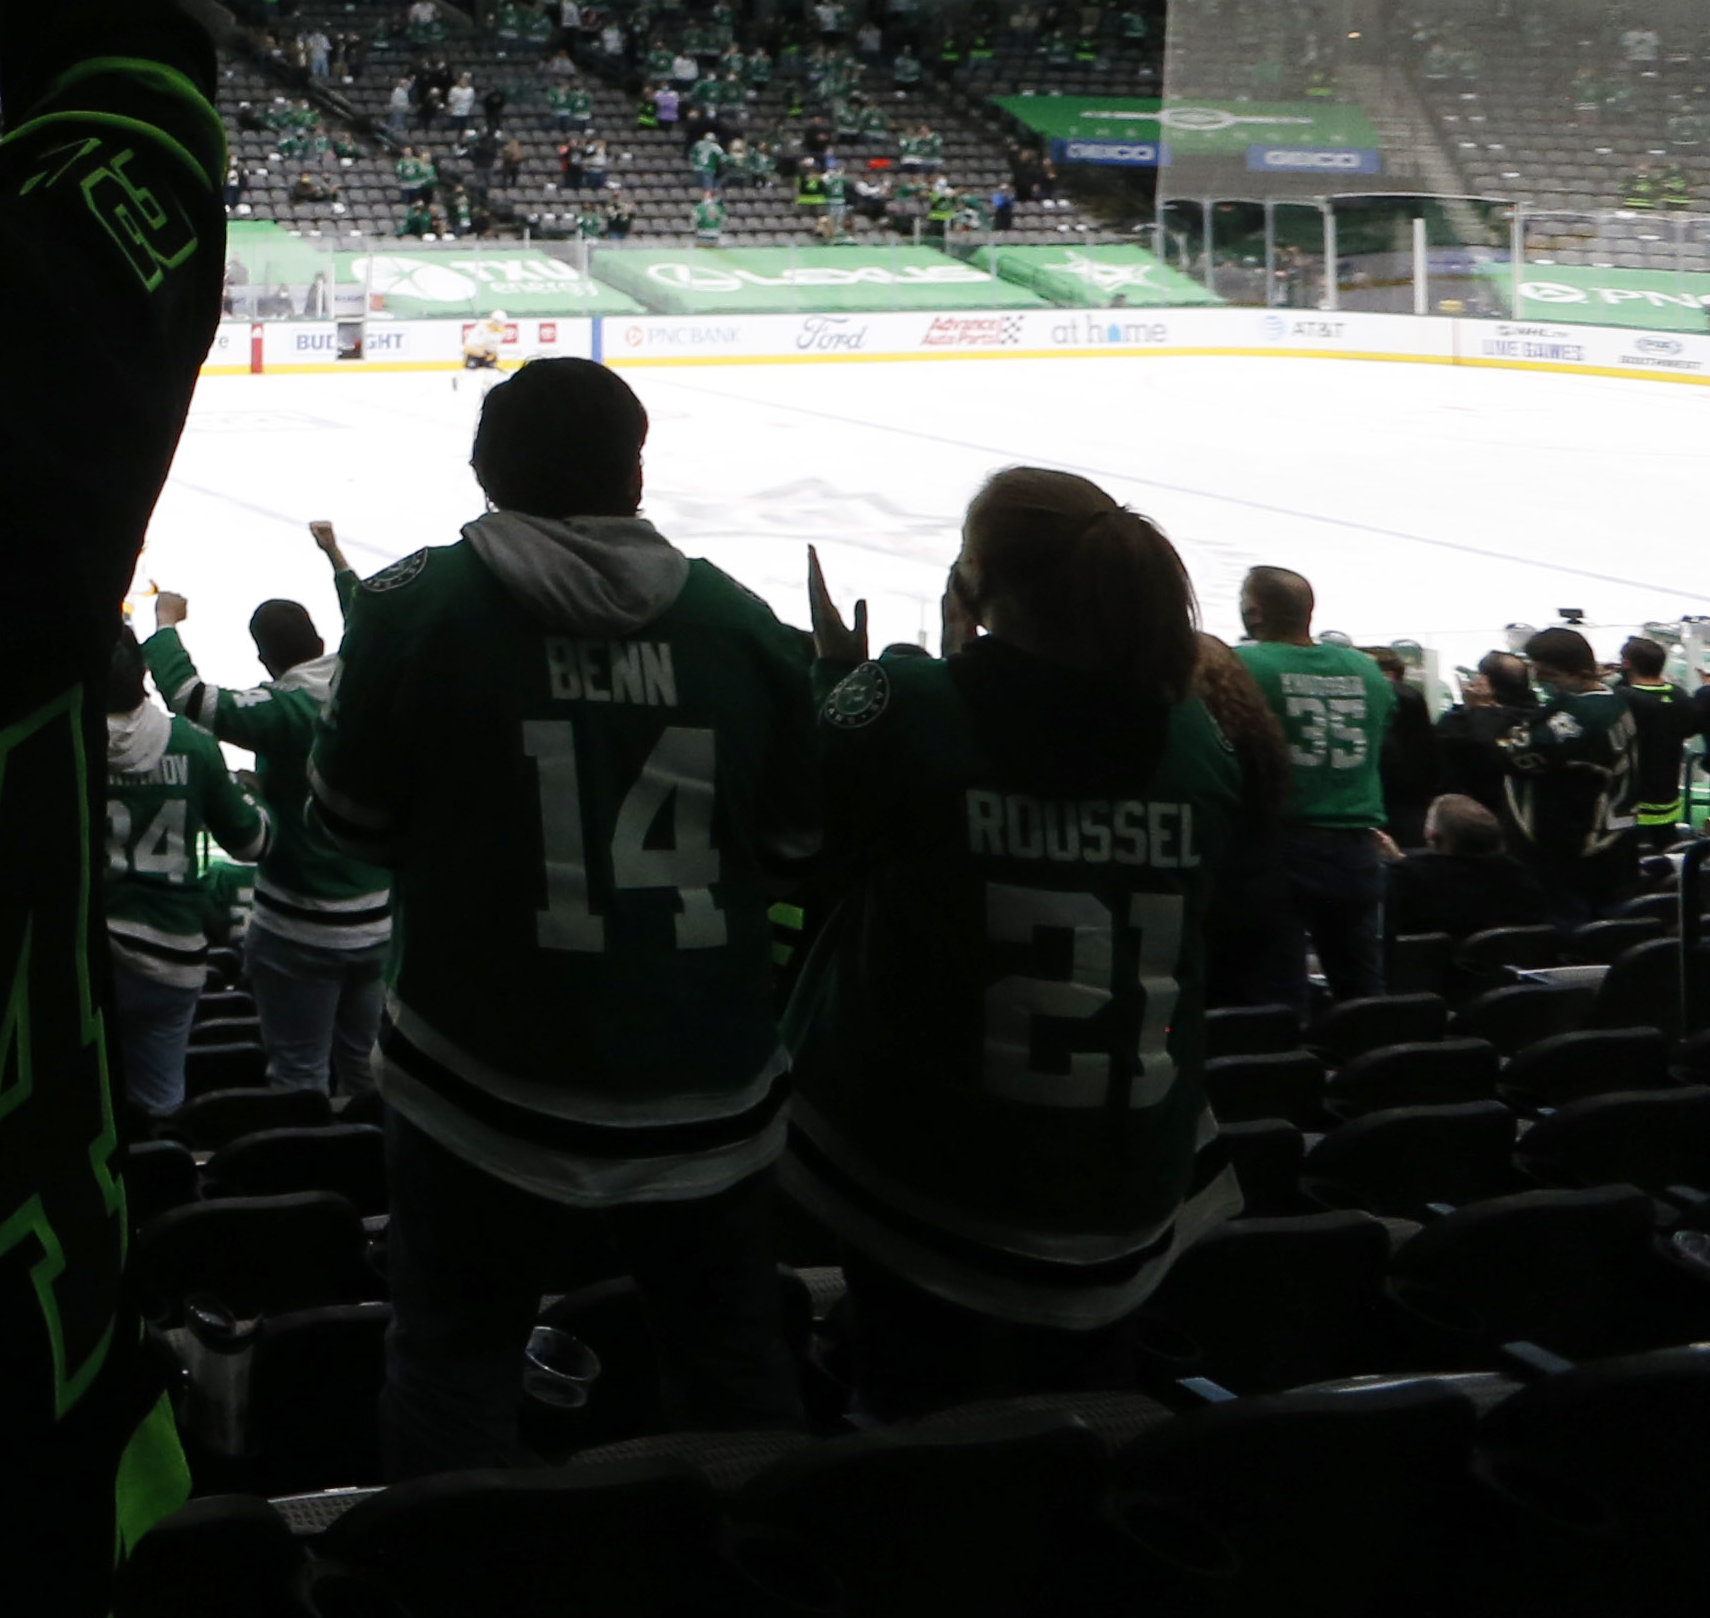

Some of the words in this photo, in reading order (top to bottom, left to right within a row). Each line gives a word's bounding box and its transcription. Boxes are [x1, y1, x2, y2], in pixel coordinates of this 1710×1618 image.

[449, 257, 583, 282] TXU
[795, 314, 870, 351] Ford
[544, 634, 679, 708] BENN
[1284, 696, 1369, 772] 35
[521, 719, 729, 954] 14
[966, 789, 1202, 869] ROUSSEL
[982, 881, 1186, 1110] 21
